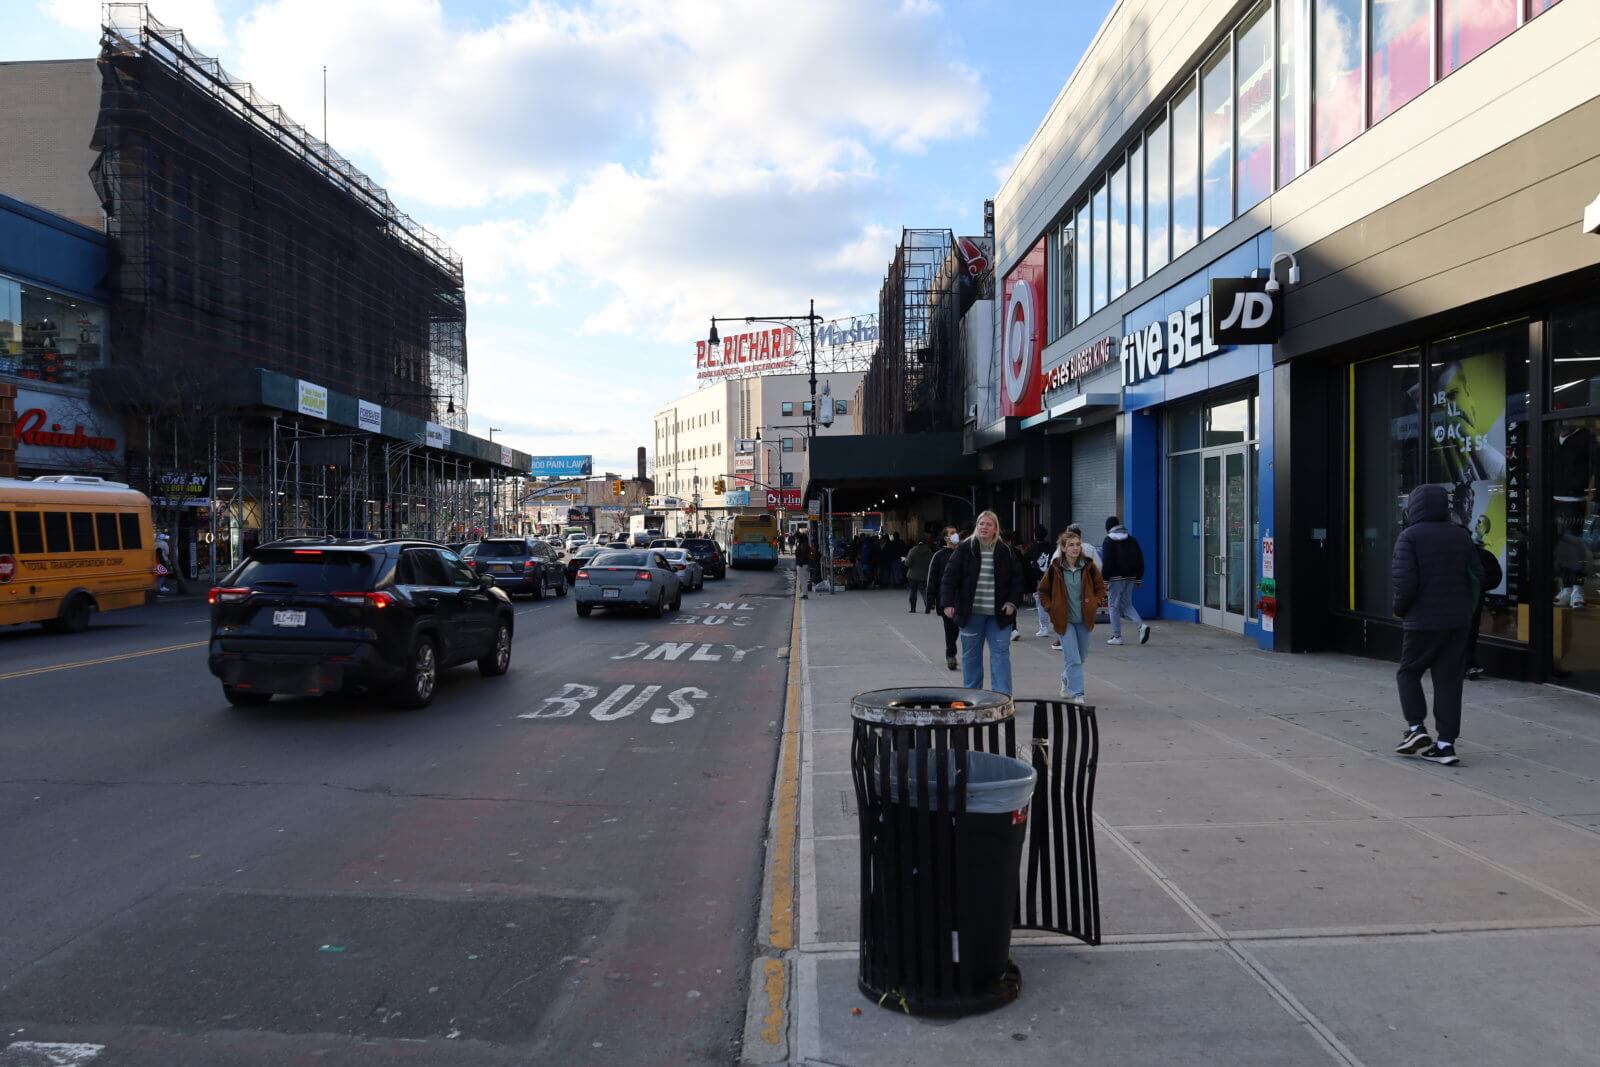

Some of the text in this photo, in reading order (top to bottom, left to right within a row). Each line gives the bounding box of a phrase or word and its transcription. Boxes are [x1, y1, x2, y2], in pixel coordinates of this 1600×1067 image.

[1219, 292, 1274, 331] JD
[723, 326, 795, 365] RICHARD
[816, 320, 880, 347] Marsha
[1167, 294, 1219, 370] BEL
[744, 360, 794, 373] ELECTRONICS
[1070, 346, 1093, 380] BURGER
[1093, 335, 1111, 368] KING
[15, 408, 117, 451] Rainbow
[546, 460, 565, 469] PAIN
[566, 459, 584, 469] LAW
[26, 560, 48, 571] TOTAL
[50, 558, 105, 570] TRANSPORTATION
[669, 614, 753, 627] BUS
[516, 683, 709, 724] BUS
